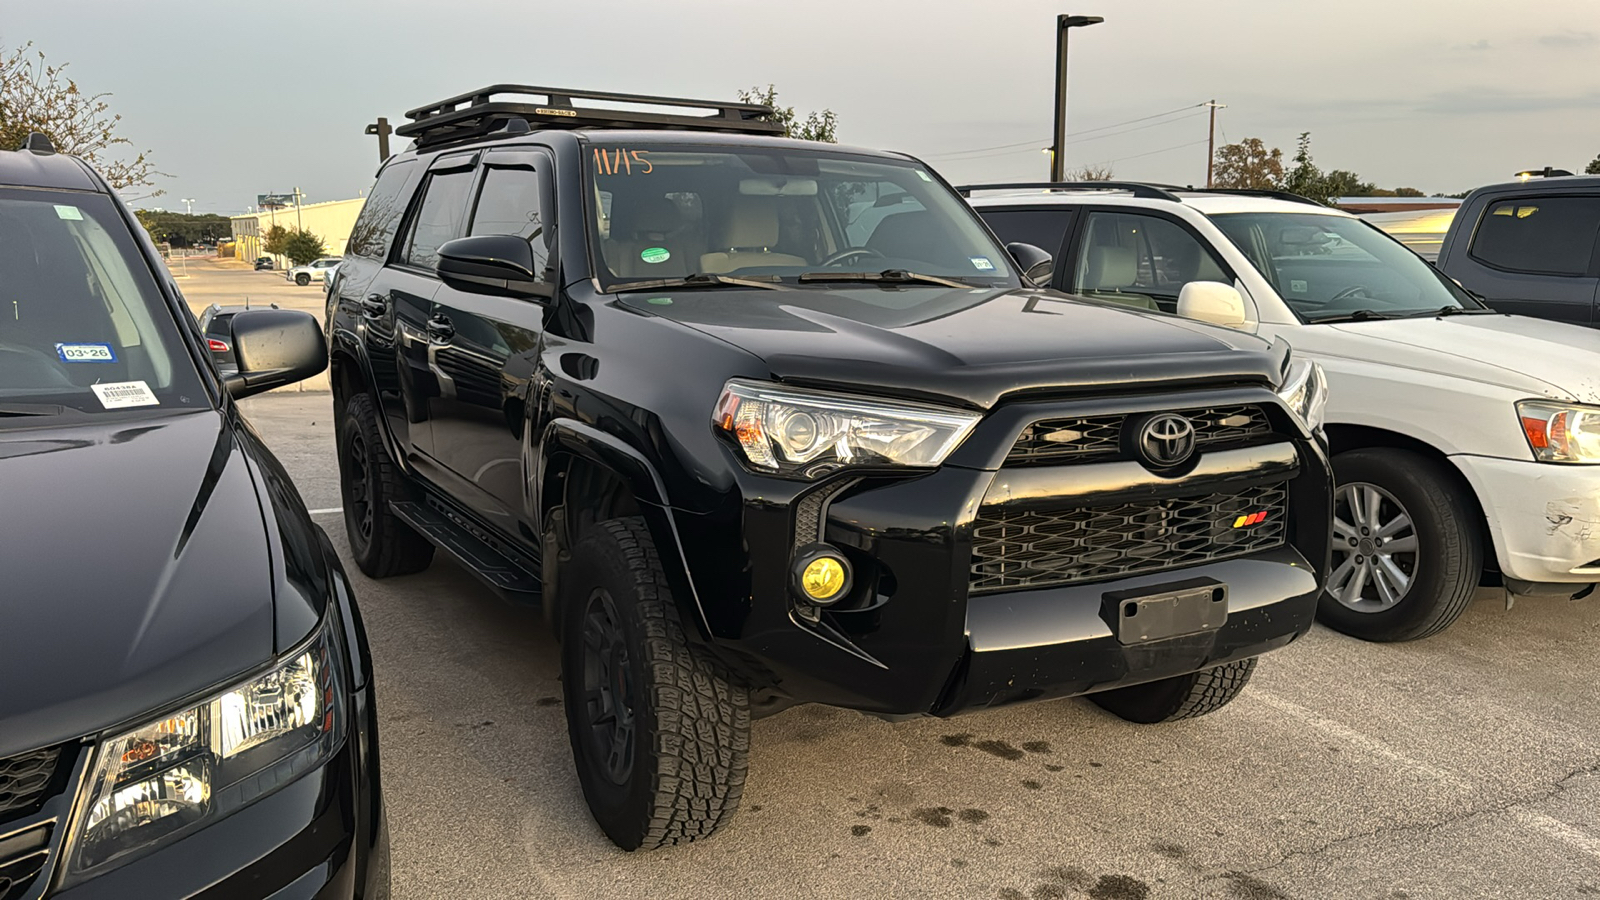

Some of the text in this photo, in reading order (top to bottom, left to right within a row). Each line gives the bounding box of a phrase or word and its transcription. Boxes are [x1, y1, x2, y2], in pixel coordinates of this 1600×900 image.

[594, 148, 653, 175] 11/15
[66, 349, 108, 357] 03 26
